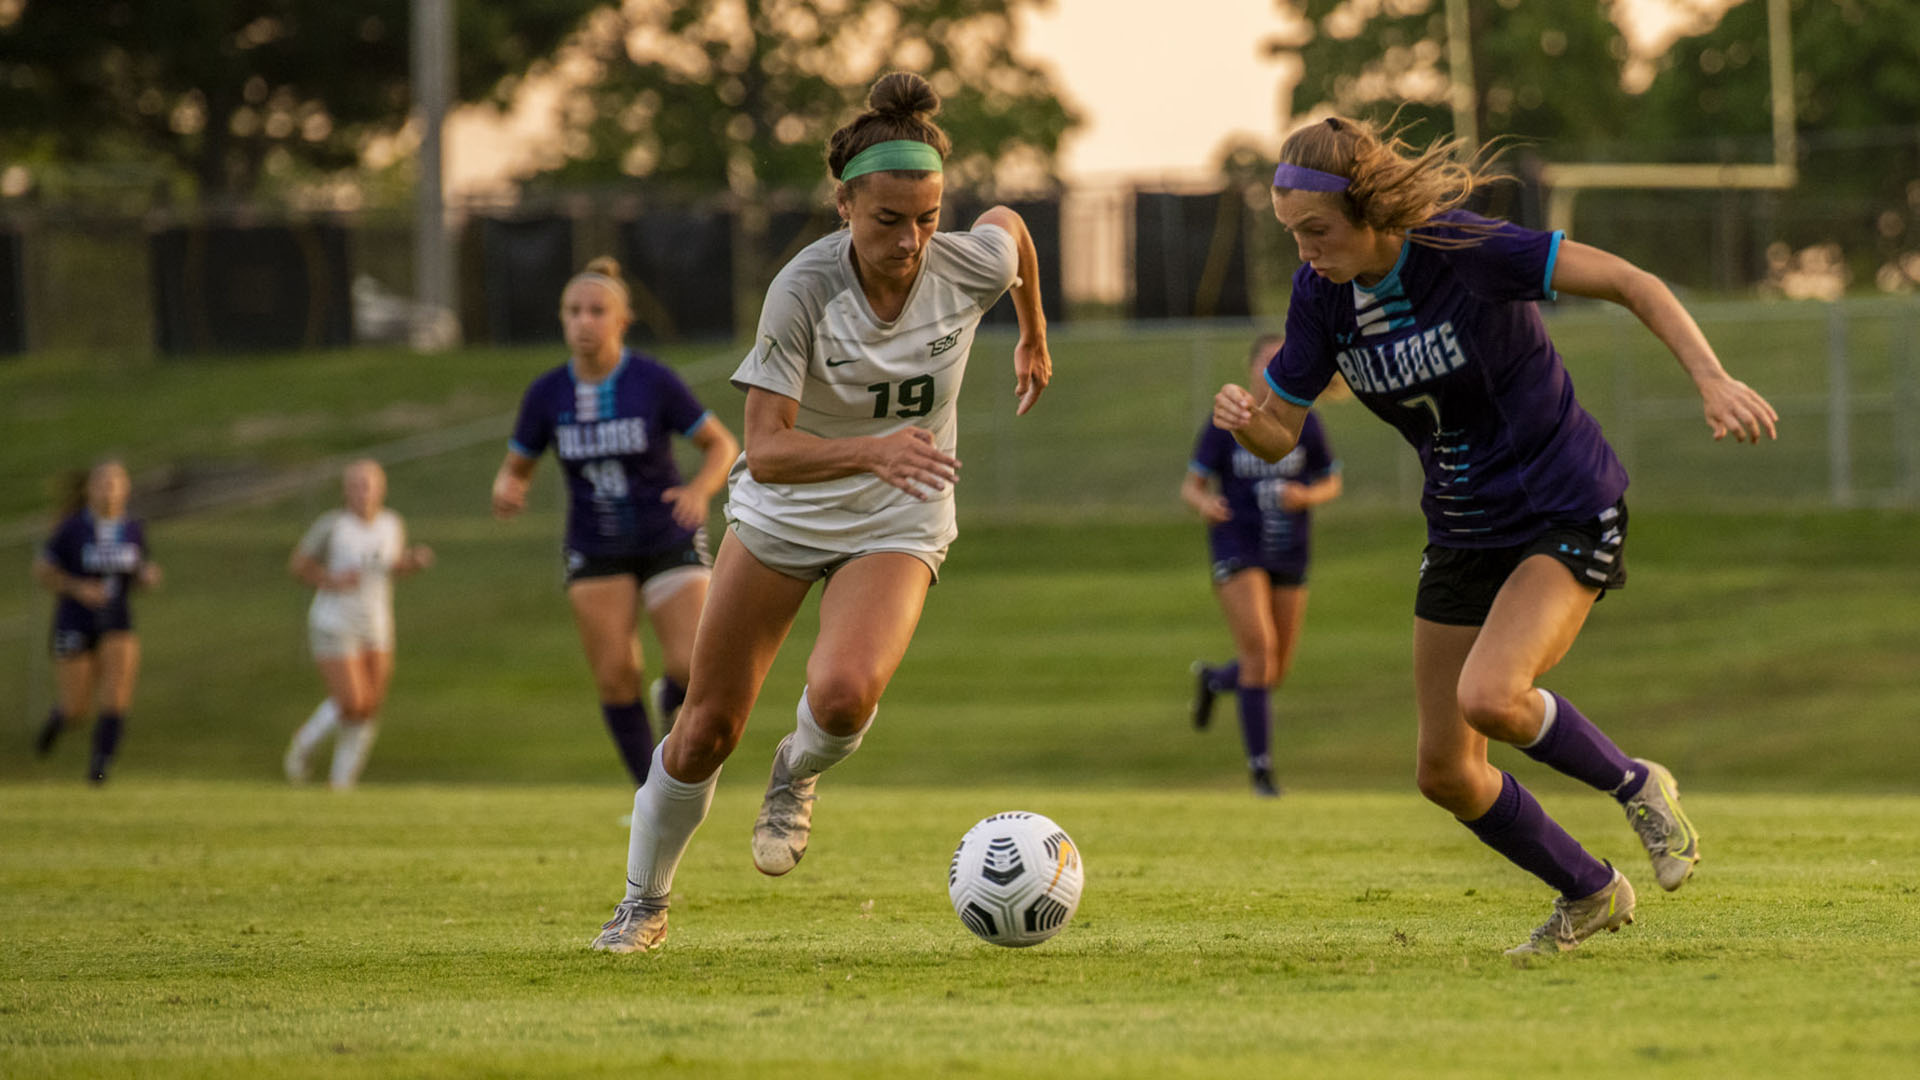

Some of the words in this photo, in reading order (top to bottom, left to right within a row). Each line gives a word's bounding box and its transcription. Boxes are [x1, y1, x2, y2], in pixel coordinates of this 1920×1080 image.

[1335, 320, 1466, 392] BULLDOGS
[867, 374, 935, 418] 19
[1401, 394, 1441, 437] 7
